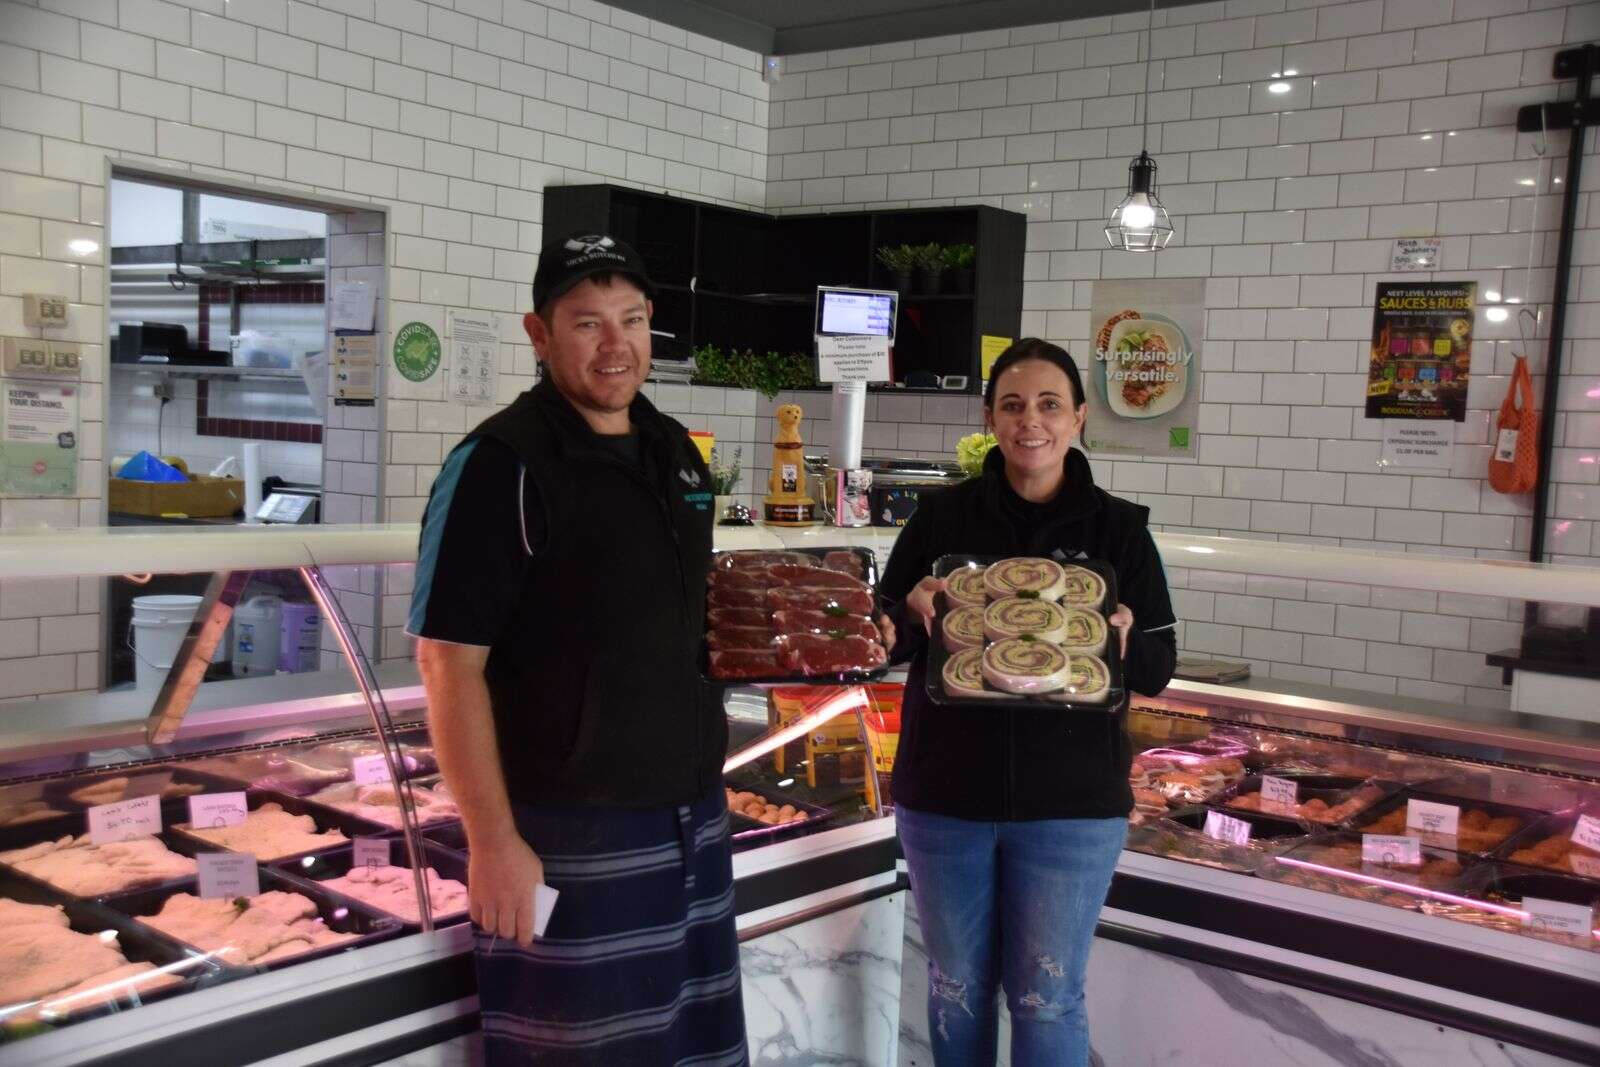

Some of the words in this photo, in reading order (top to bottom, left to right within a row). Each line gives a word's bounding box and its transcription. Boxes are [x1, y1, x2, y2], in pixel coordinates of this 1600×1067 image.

[1380, 298, 1427, 309] SAUCES
[1428, 299, 1437, 310] &
[1438, 298, 1472, 309] RUBS
[1096, 347, 1193, 366] Surprisingly
[1106, 367, 1179, 381] versatile.
